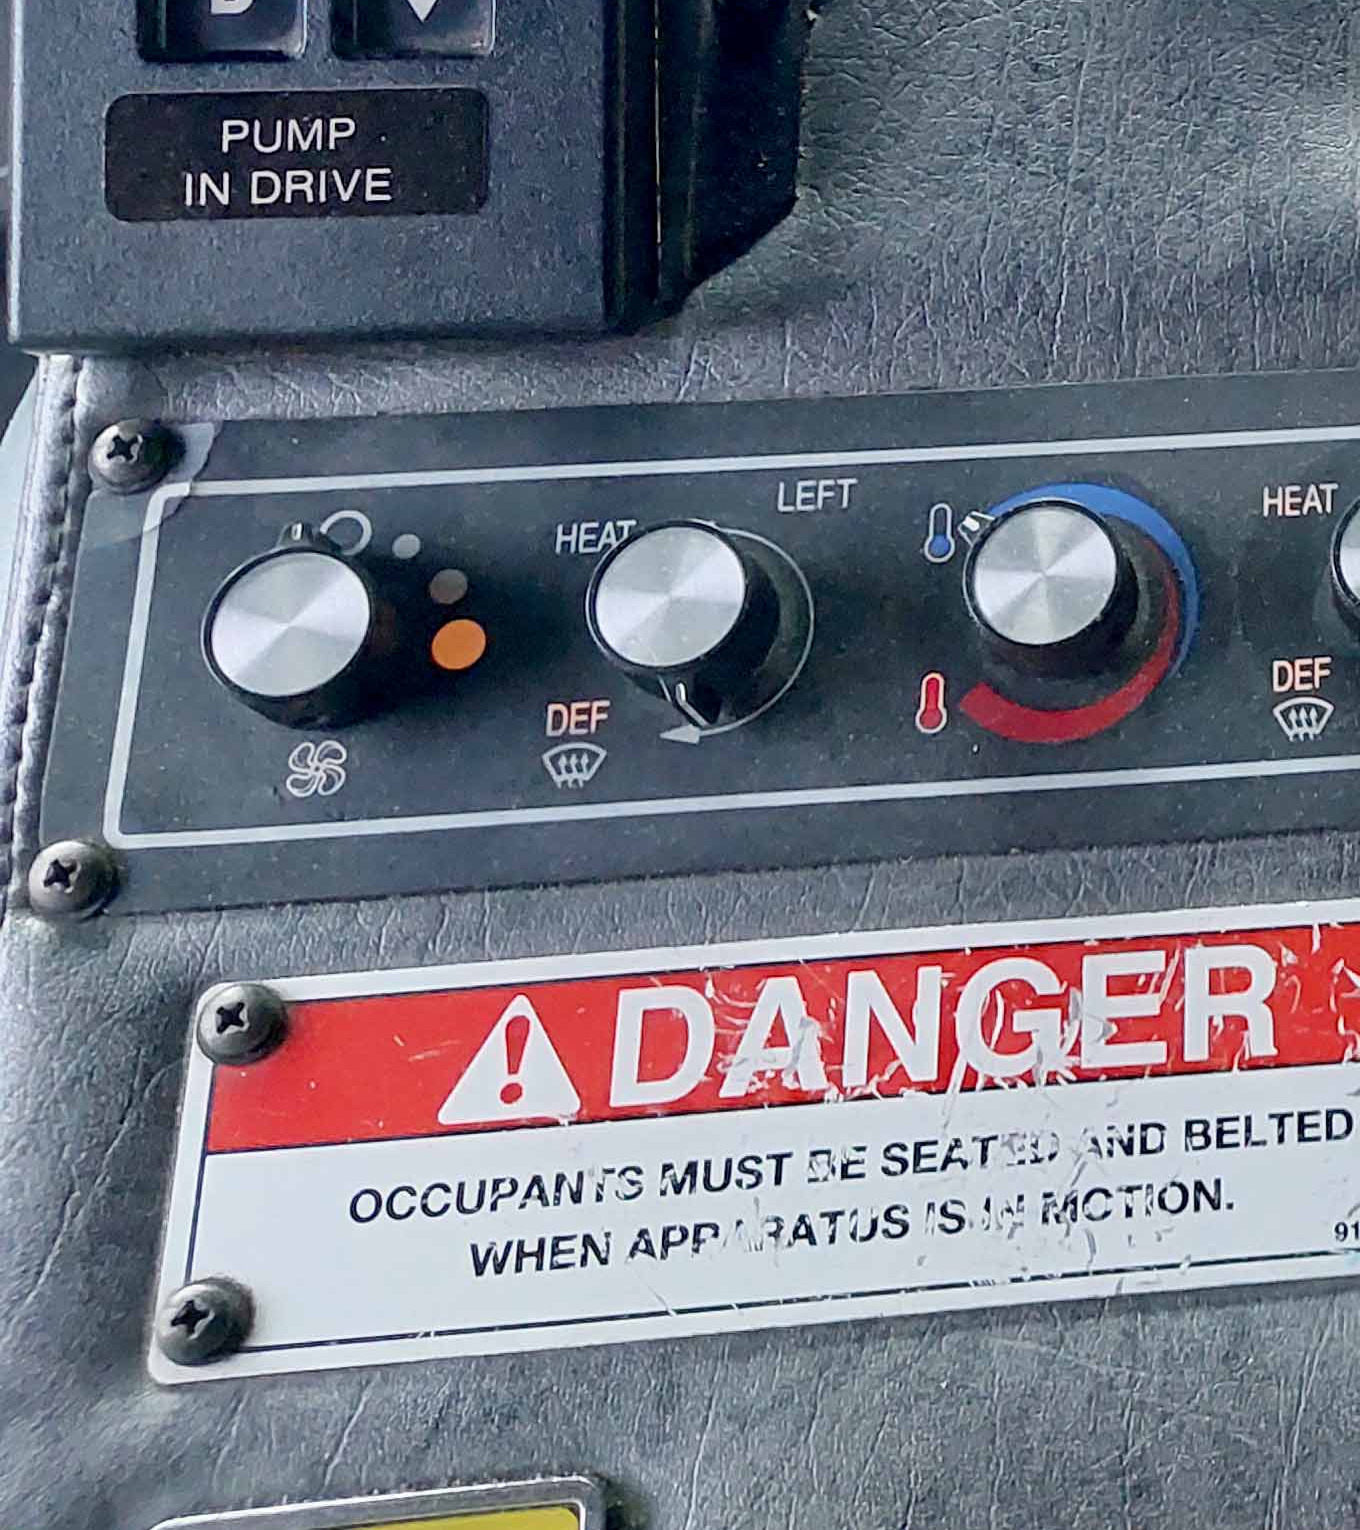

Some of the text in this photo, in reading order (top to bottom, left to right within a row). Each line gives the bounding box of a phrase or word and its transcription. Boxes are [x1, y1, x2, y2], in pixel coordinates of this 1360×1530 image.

[222, 117, 356, 154] PUMP
[185, 168, 392, 207] IN DRIVE
[778, 478, 857, 513] LEFT
[1263, 483, 1338, 517] HEAT
[556, 519, 636, 555] HEAT
[1273, 656, 1332, 691] DEF
[547, 700, 610, 737] DEF
[609, 944, 1278, 1110] DANGER
[350, 1167, 644, 1224] OCCUPANTS
[659, 1149, 792, 1197] MUST
[1185, 1108, 1354, 1152] BELTED
[470, 1231, 612, 1277] WHEN
